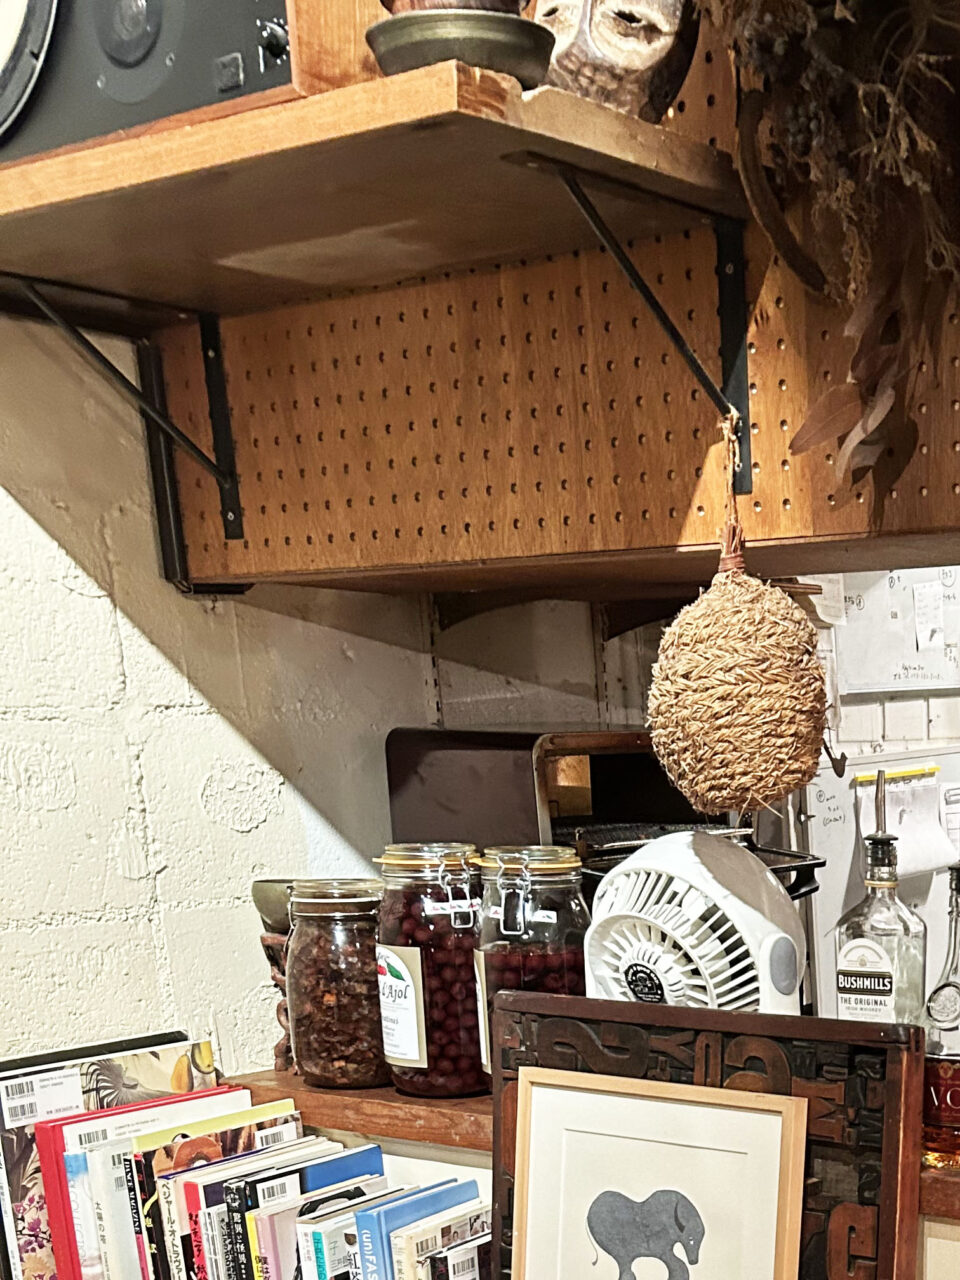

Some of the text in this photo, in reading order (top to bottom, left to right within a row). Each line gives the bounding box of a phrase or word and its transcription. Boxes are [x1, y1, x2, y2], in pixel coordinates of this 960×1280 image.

[838, 974, 892, 991] BUSHMILLS
[840, 996, 888, 1007] THE ORIGINAL
[124, 1160, 140, 1233] DANCE MAGAZINE
[233, 1212, 247, 1264] 驚異と怪異
